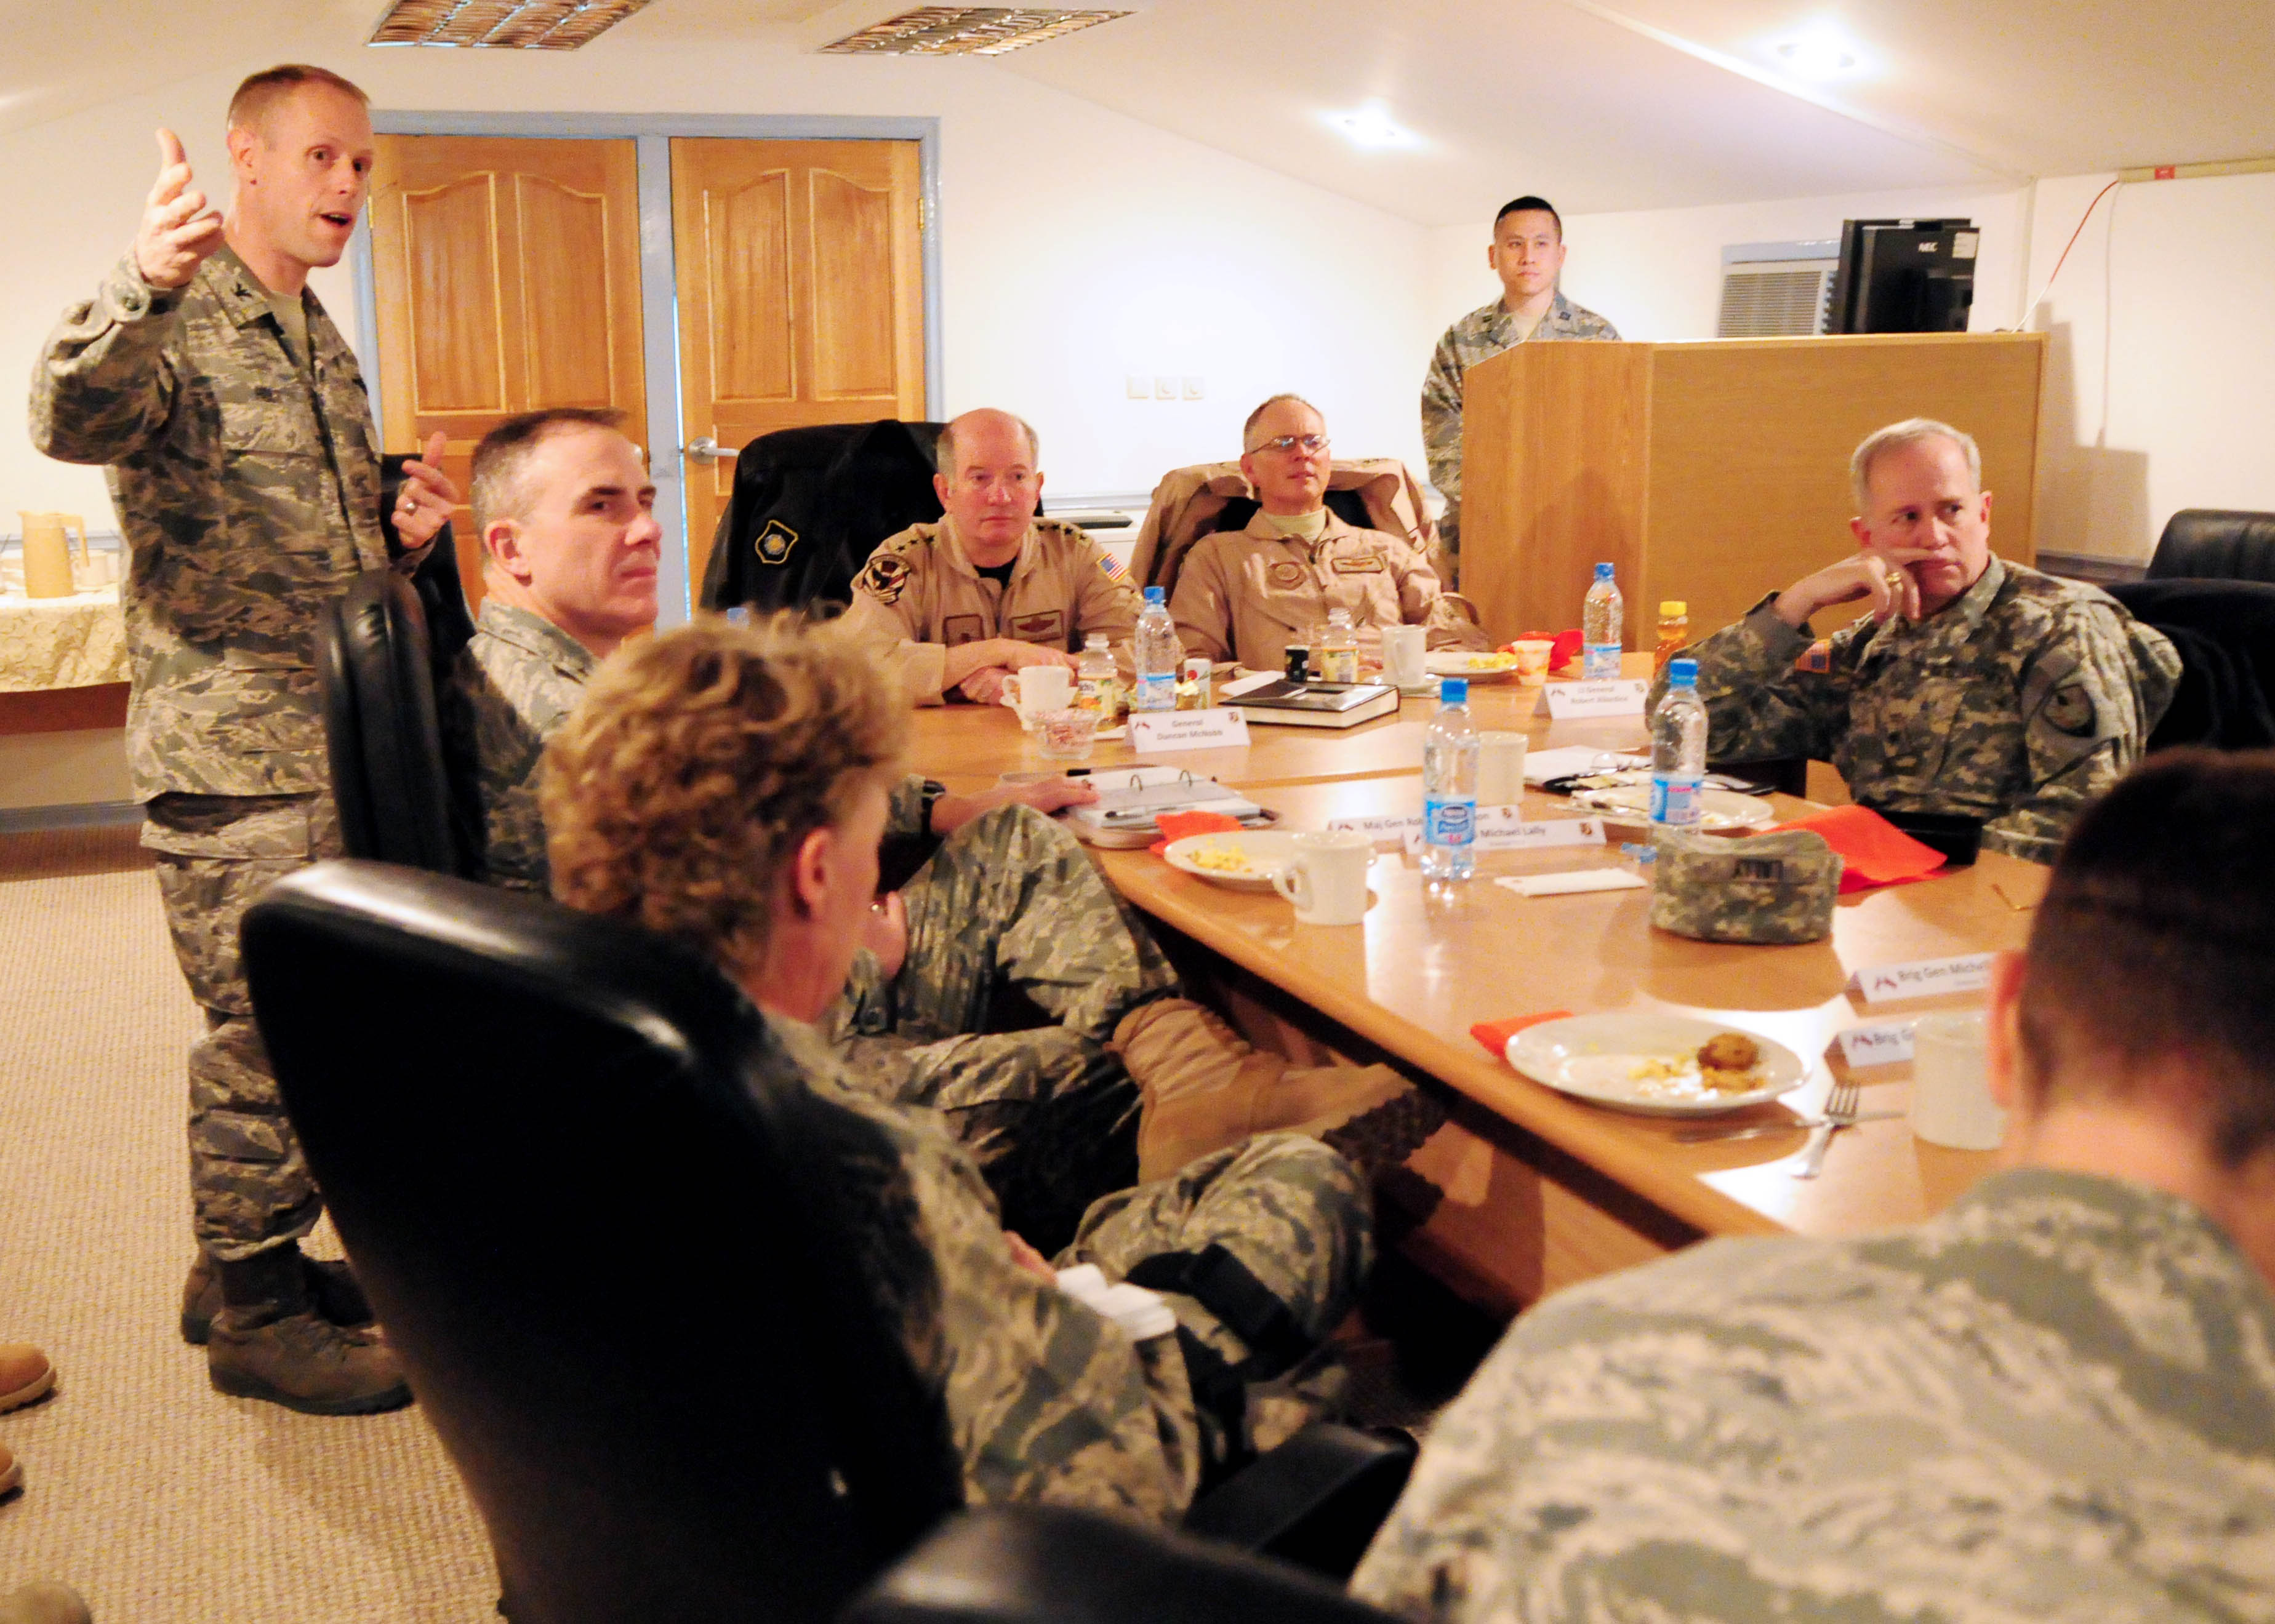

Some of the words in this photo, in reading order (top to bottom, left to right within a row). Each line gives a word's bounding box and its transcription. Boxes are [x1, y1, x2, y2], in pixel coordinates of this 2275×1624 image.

[1918, 242, 1938, 252] NEC
[1171, 718, 1203, 728] General
[1157, 731, 1187, 741] Duncan
[1362, 819, 1383, 831] Maj
[1385, 818, 1405, 828] Gen
[1406, 817, 1424, 826] Rob
[1480, 826, 1520, 838] Michael
[1897, 970, 1923, 982] Brig
[1924, 967, 1946, 978] Gen
